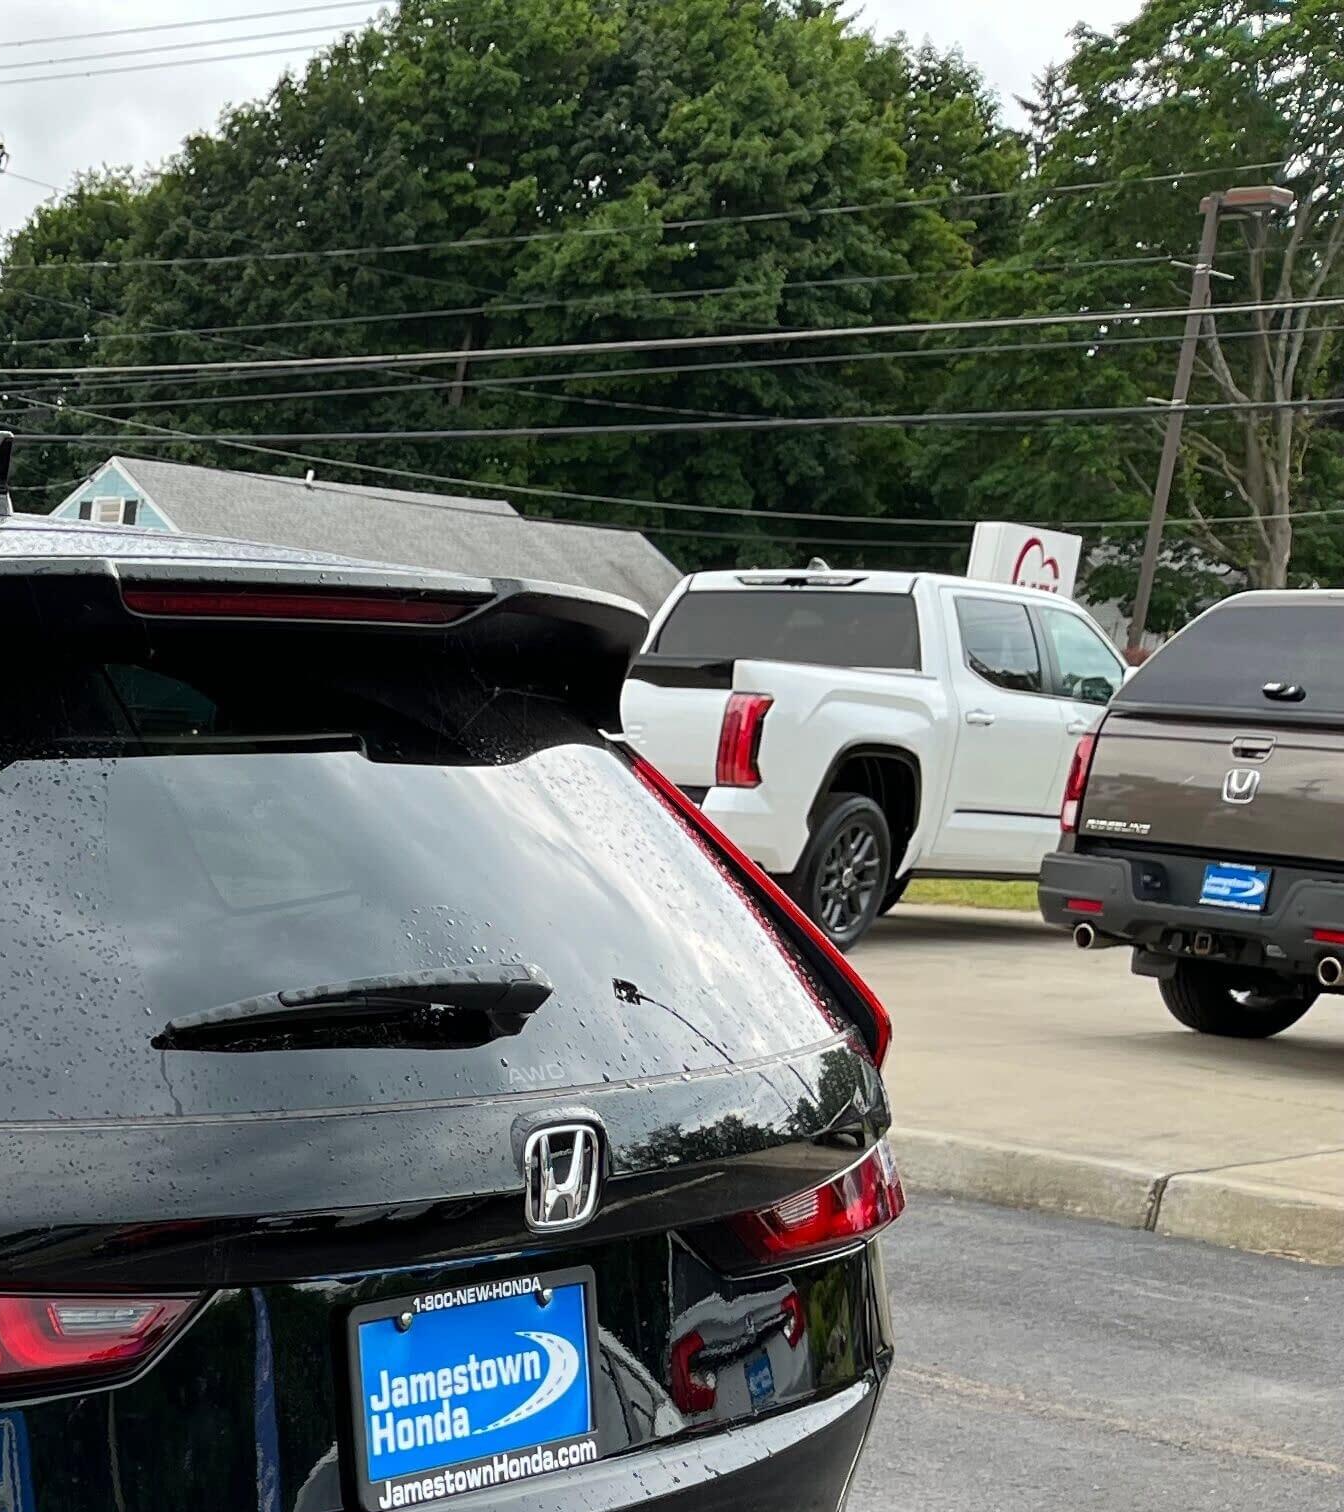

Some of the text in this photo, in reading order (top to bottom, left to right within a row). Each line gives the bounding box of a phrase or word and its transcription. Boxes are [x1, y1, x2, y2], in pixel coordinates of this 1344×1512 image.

[509, 1064, 565, 1085] AWD
[413, 1277, 541, 1313] 1-800-NEW-HONDA
[370, 1350, 540, 1412] Jamestown
[371, 1397, 470, 1456] Honda
[379, 1438, 597, 1510] JamestownHonda.com
